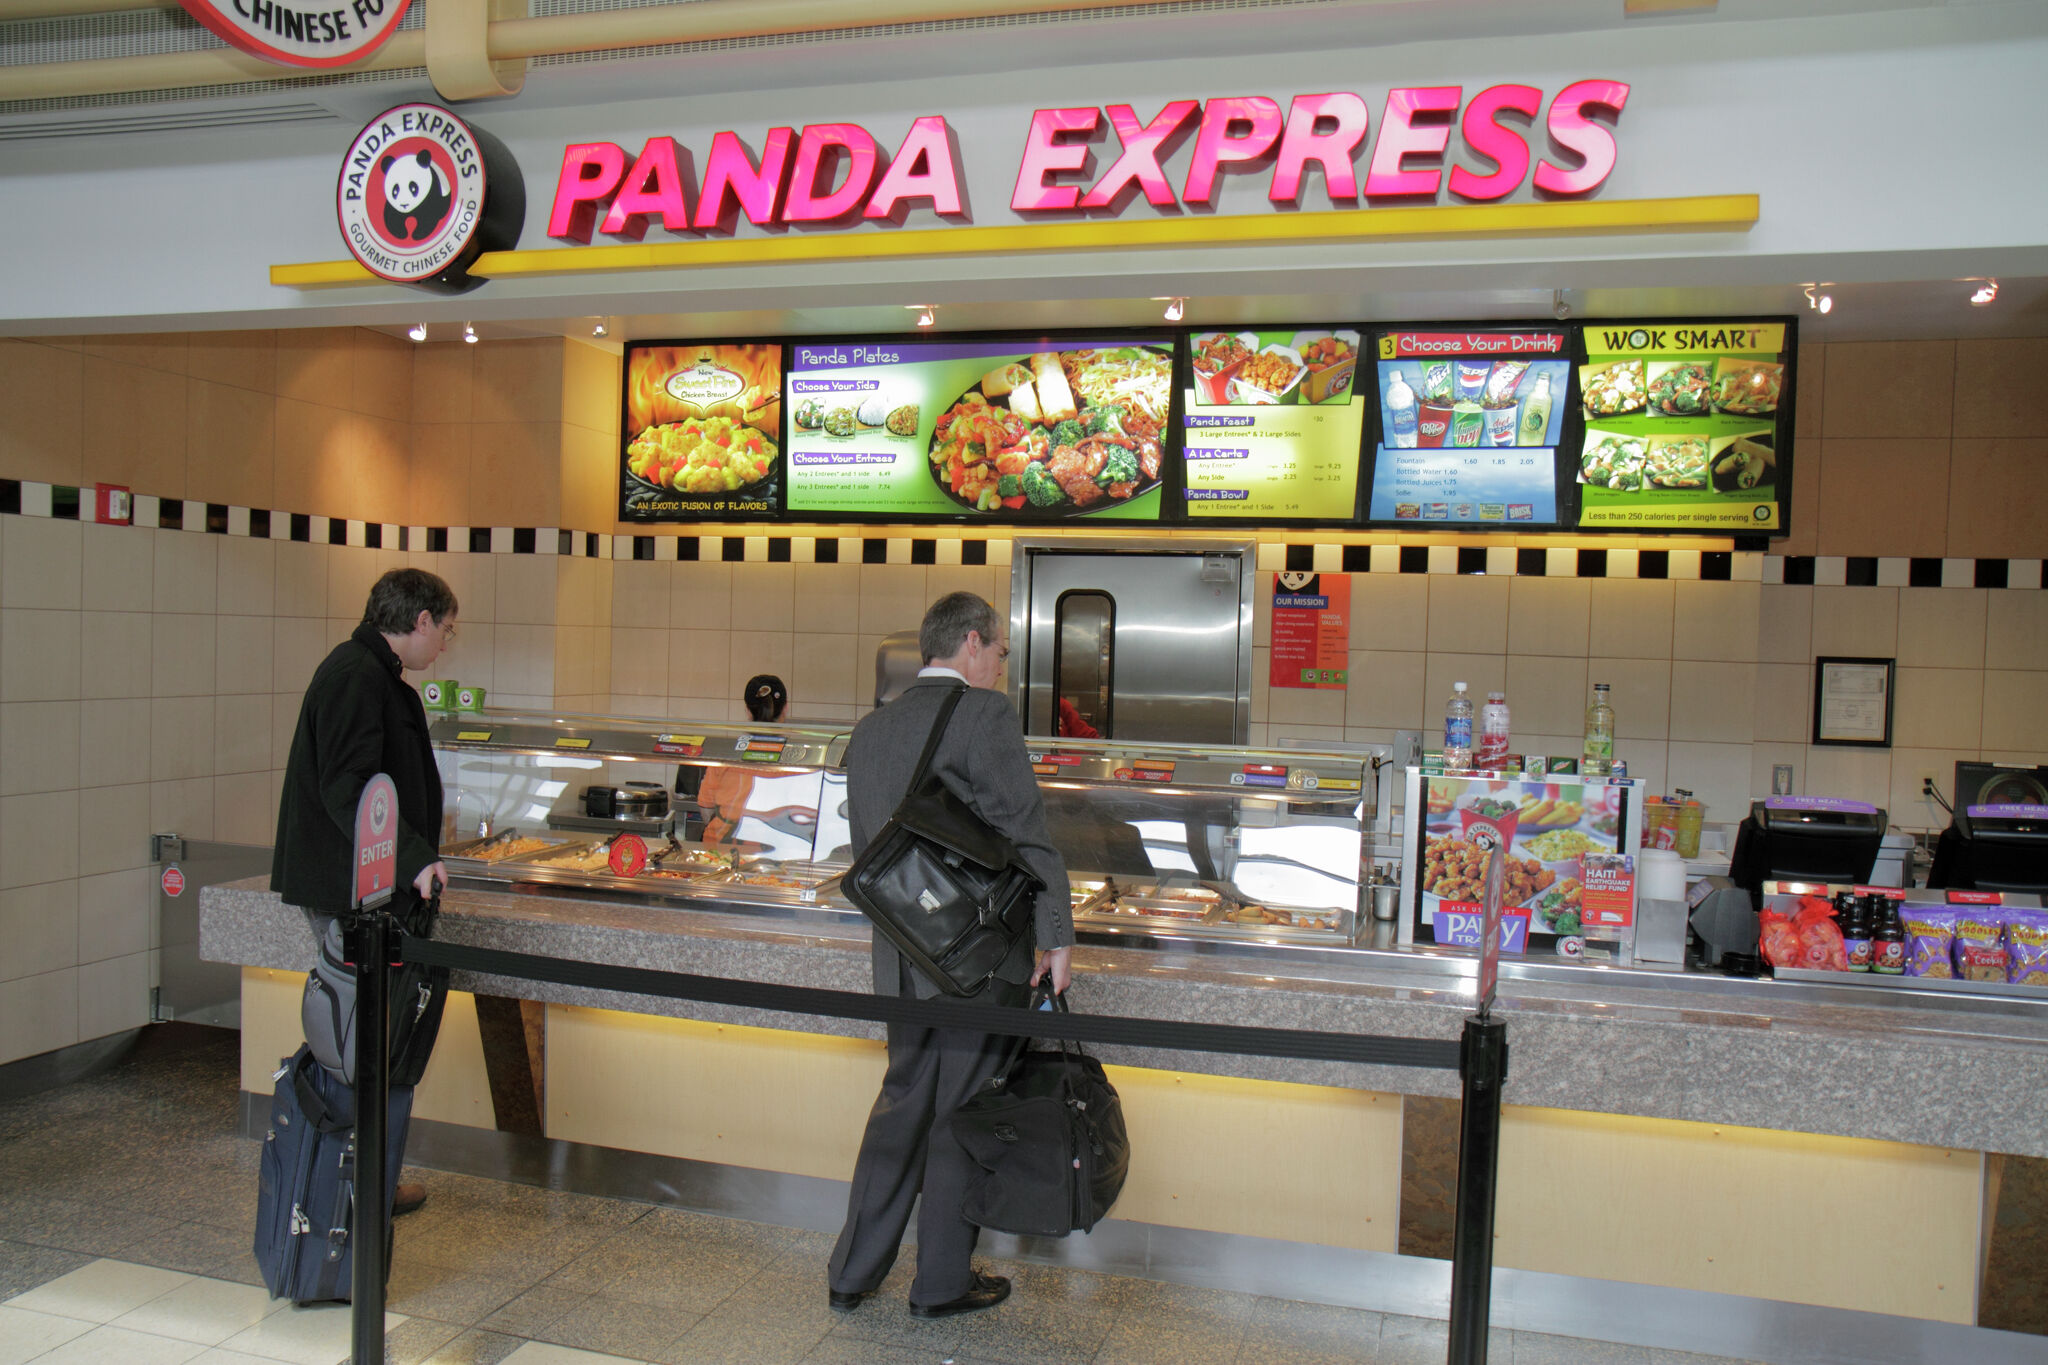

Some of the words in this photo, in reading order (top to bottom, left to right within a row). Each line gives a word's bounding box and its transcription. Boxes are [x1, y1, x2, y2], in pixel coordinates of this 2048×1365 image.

[345, 122, 396, 201] PANDA
[402, 111, 478, 179] EXPRESS
[547, 114, 968, 240] PANDA
[1009, 79, 1632, 212] EXPRESS
[350, 223, 399, 272] GOURMET
[403, 242, 455, 274] CHINESE
[453, 200, 477, 242] FOOD
[1384, 339, 1393, 355] 3
[1400, 335, 1462, 352] Choose
[1466, 334, 1508, 352] Your
[1510, 333, 1557, 353] Drink
[1603, 328, 1667, 351] WOK
[1674, 328, 1762, 350] SMART
[801, 347, 848, 365] Panda
[852, 346, 900, 364] Plates
[795, 381, 830, 391] Choose
[831, 381, 855, 391] Your
[856, 380, 876, 390] Side
[1190, 416, 1222, 426] Panda
[1223, 416, 1250, 426] Feast
[795, 453, 830, 463] Choose
[831, 453, 854, 463] Your
[855, 452, 893, 463] Entrees
[1188, 449, 1197, 458] A
[1199, 449, 1212, 458] La
[1187, 489, 1218, 499] Panda
[1220, 489, 1245, 499] Bowl
[636, 502, 649, 510] AN
[651, 502, 679, 510] EXOTIC
[681, 502, 711, 510] FUSION
[713, 502, 725, 510] OF
[728, 502, 768, 511] FLAVORS
[1588, 512, 1607, 520] Less
[1609, 512, 1626, 520] than
[1628, 512, 1643, 520] 250
[1644, 512, 1676, 521] calories
[1677, 514, 1690, 522] per
[1693, 513, 1717, 522] single
[1719, 514, 1749, 522] serving
[1275, 597, 1292, 606] OUR
[1293, 597, 1325, 607] MISSION
[361, 839, 393, 867] ENTER
[1585, 869, 1617, 879] HAITI
